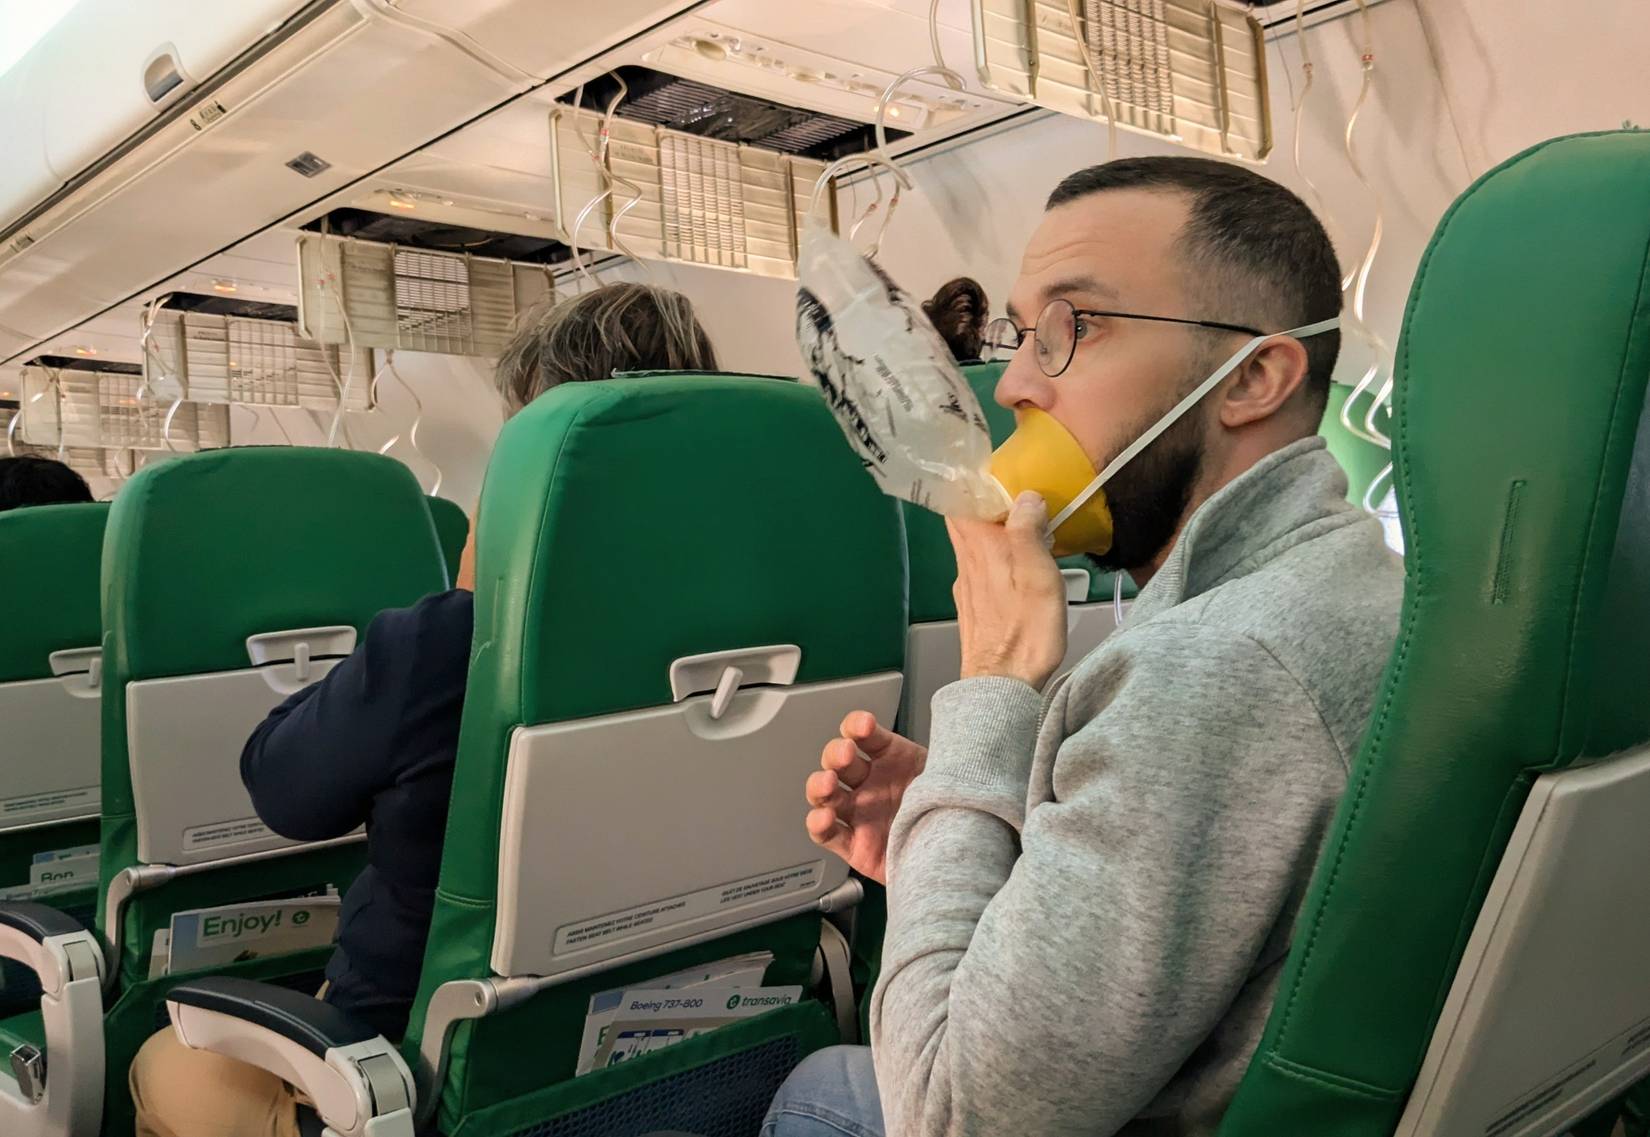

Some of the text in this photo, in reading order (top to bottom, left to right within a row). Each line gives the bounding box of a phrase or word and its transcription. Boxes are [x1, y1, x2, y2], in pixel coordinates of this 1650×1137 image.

[203, 910, 282, 937] Enjoy!
[629, 998, 703, 1012] Boeing 737-800
[742, 994, 792, 1007] transavia
